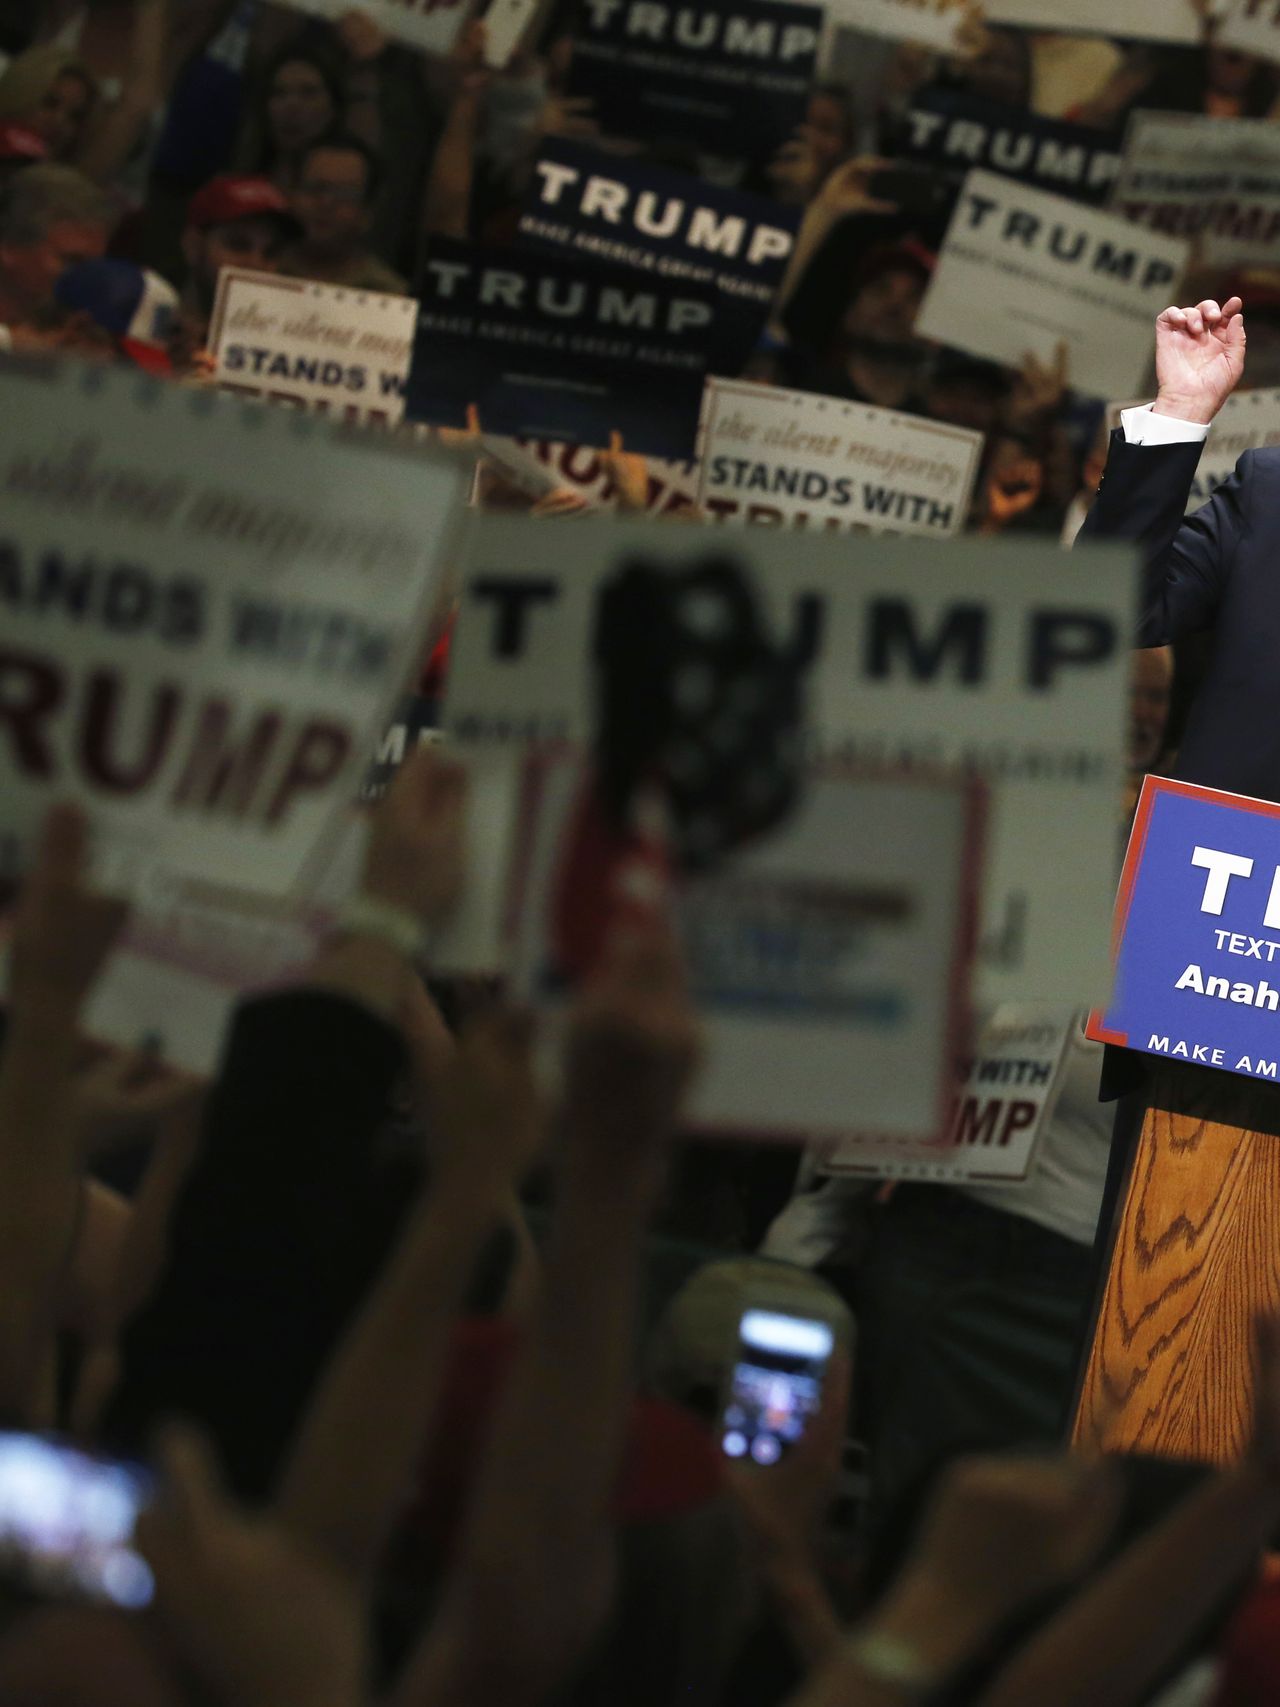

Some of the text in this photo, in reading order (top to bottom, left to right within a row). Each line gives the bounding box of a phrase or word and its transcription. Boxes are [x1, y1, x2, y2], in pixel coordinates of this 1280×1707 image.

[591, 0, 818, 61] TRUMP
[535, 159, 794, 266] TRUMP
[967, 193, 1175, 292] TRUMP
[426, 259, 716, 335] TRUMP
[224, 342, 368, 393] STANDS
[762, 420, 842, 458] silent
[847, 440, 961, 486] majority
[711, 455, 854, 508] STANDS
[861, 483, 954, 530] WITH
[978, 1057, 1054, 1083] WITH
[1147, 1033, 1226, 1066] MAKE
